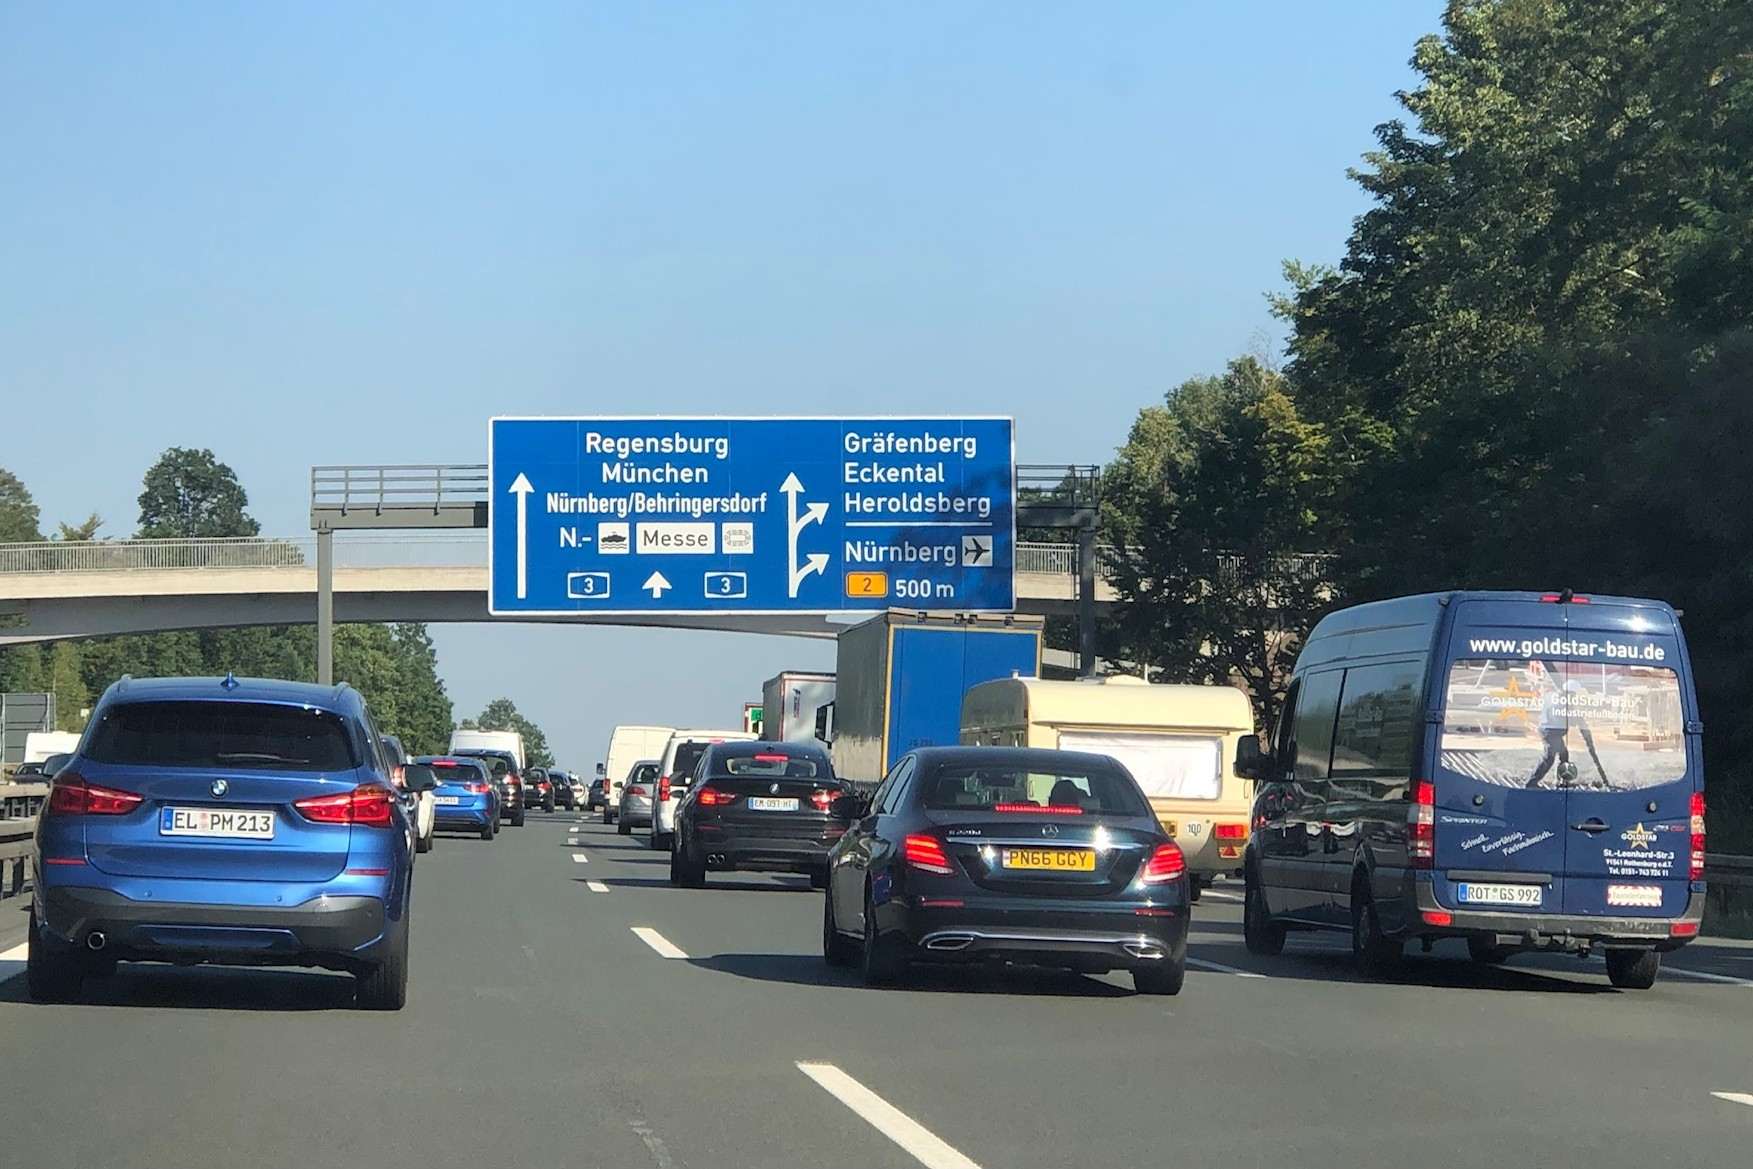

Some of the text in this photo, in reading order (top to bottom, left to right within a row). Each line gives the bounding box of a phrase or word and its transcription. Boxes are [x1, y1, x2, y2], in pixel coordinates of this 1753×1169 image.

[586, 432, 729, 459] Regensburg
[844, 432, 977, 458] Gräfenberg
[602, 462, 709, 483] München
[845, 462, 945, 483] Eckental
[547, 492, 768, 518] Nürnberg/Behringersdorf
[845, 492, 991, 518] Heroldsberg
[643, 530, 709, 547] Messe
[846, 541, 957, 566] Nürnberg
[584, 578, 594, 593] 3
[720, 578, 731, 593] 3
[863, 577, 872, 592] 2
[895, 580, 954, 597] 500 m
[1470, 637, 1665, 661] www.goldstar-bau.de
[175, 812, 271, 832] EL PM 213
[1621, 833, 1657, 841] GOLDSTAR
[1009, 851, 1087, 867] PN66 GGY
[1468, 887, 1540, 902] ROT GS 992
